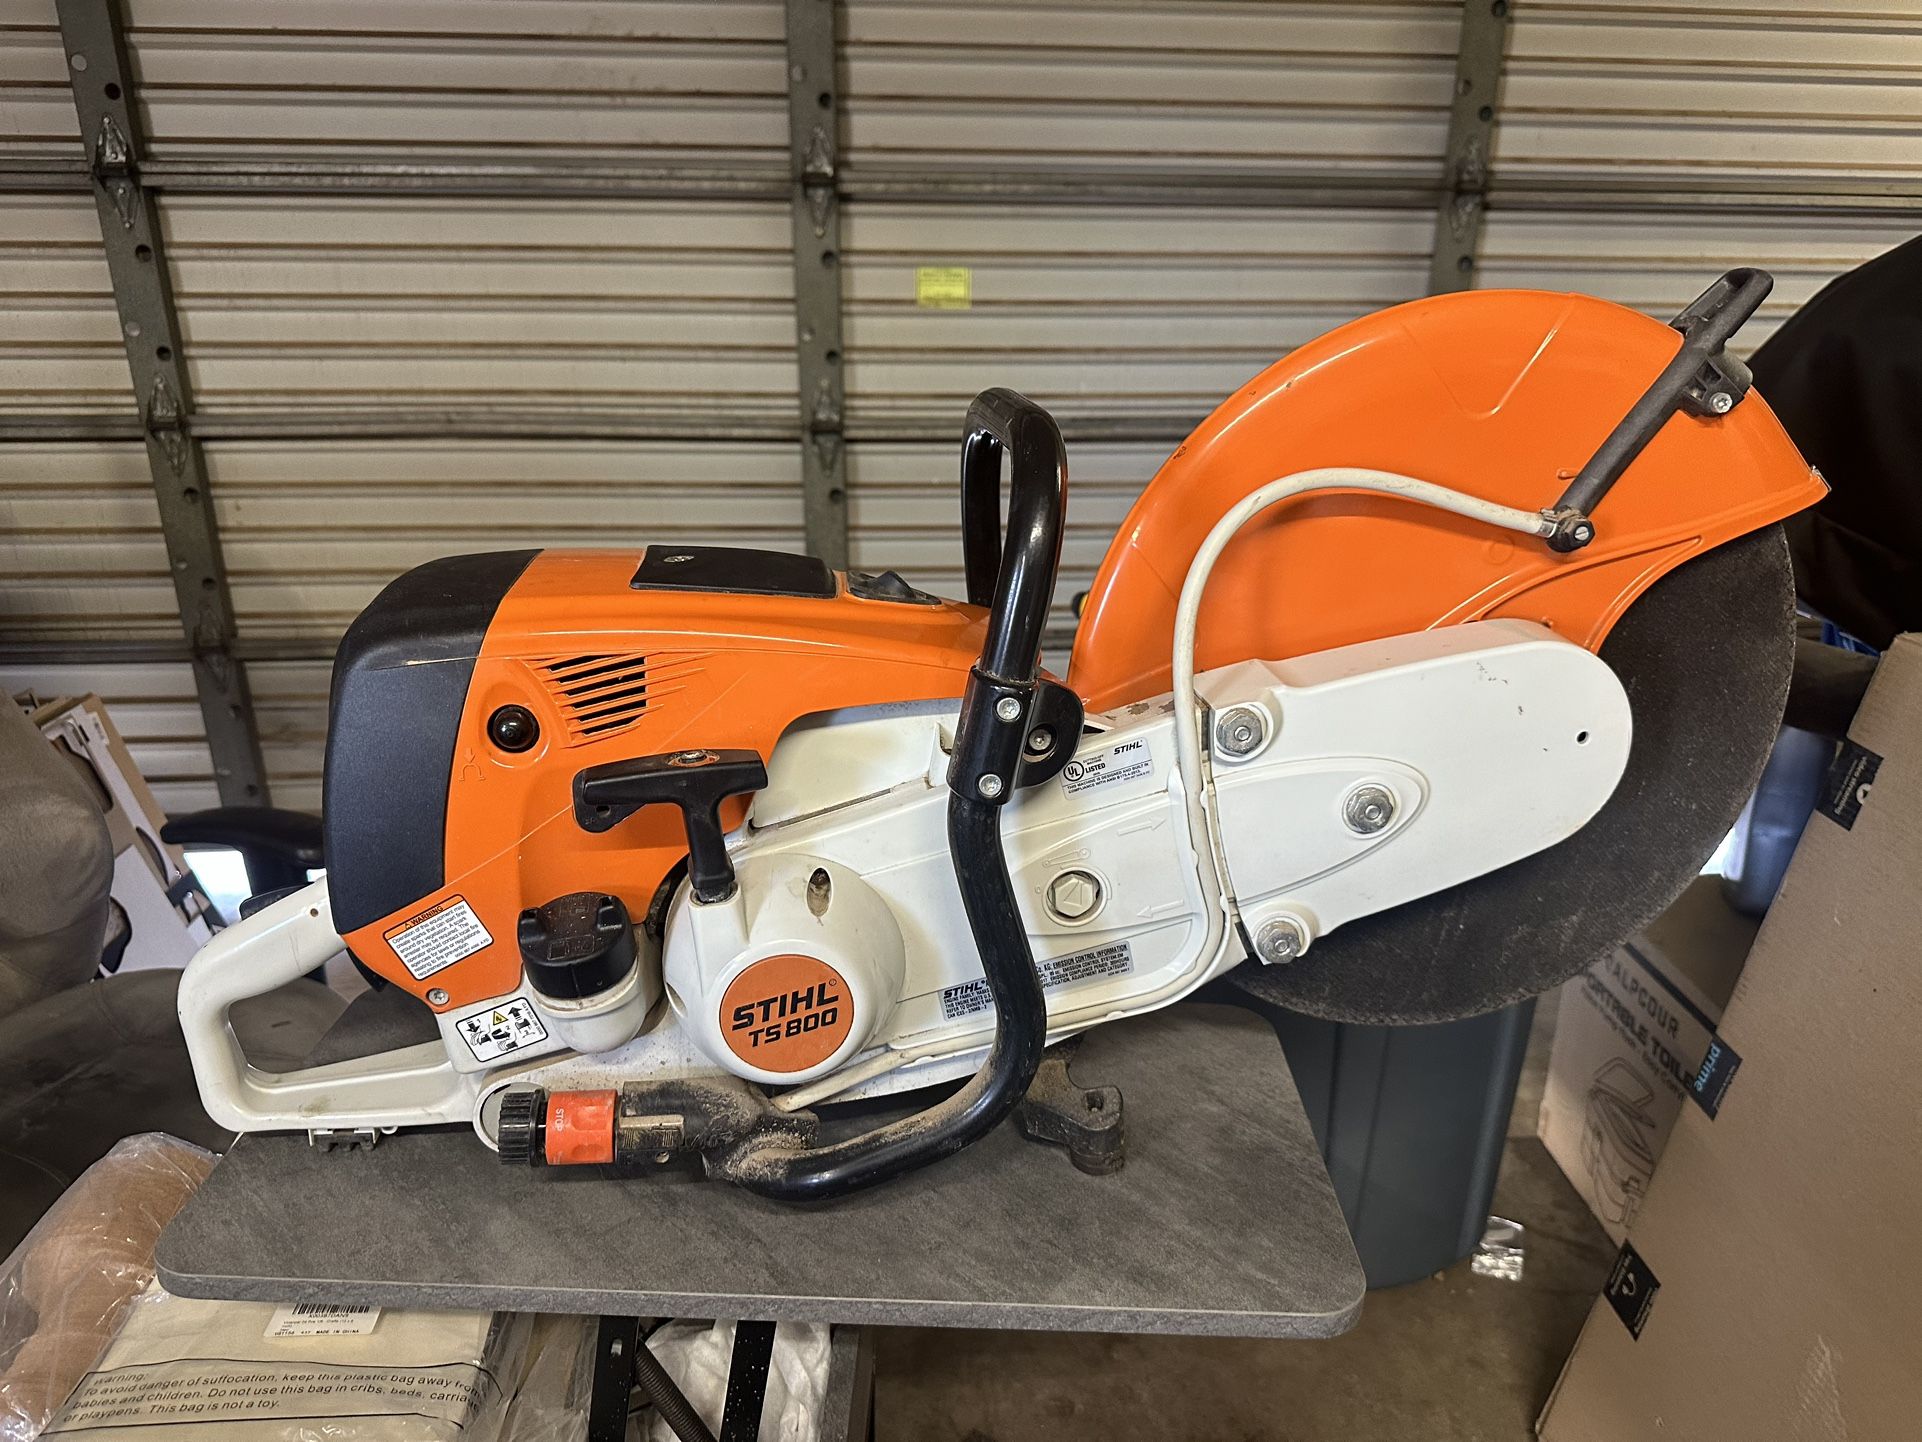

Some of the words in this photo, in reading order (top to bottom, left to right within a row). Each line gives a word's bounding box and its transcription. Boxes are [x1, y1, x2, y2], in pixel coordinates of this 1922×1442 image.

[1085, 763, 1105, 773] LISTED
[411, 906, 443, 925] WARNING
[1097, 945, 1128, 957] INFORMATION
[732, 982, 839, 1031] STIHL
[749, 1024, 782, 1047] TS
[785, 1008, 837, 1037] 800
[1693, 1041, 1721, 1092] prime
[555, 1108, 564, 1132] STOP
[100, 1385, 137, 1395] avoid
[139, 1379, 185, 1391] danger
[187, 1375, 201, 1386] of
[391, 1374, 414, 1386] bag
[418, 1377, 452, 1386] away
[73, 1397, 116, 1409] babies
[119, 1394, 145, 1405] and
[208, 1388, 226, 1397] Do
[230, 1387, 251, 1396] not
[253, 1387, 277, 1395] use
[280, 1385, 304, 1394] this
[307, 1384, 333, 1394] bag
[351, 1384, 385, 1395] cribs,
[149, 1404, 177, 1414] This
[179, 1404, 205, 1414] bag
[208, 1403, 218, 1411] is
[221, 1400, 244, 1410] not
